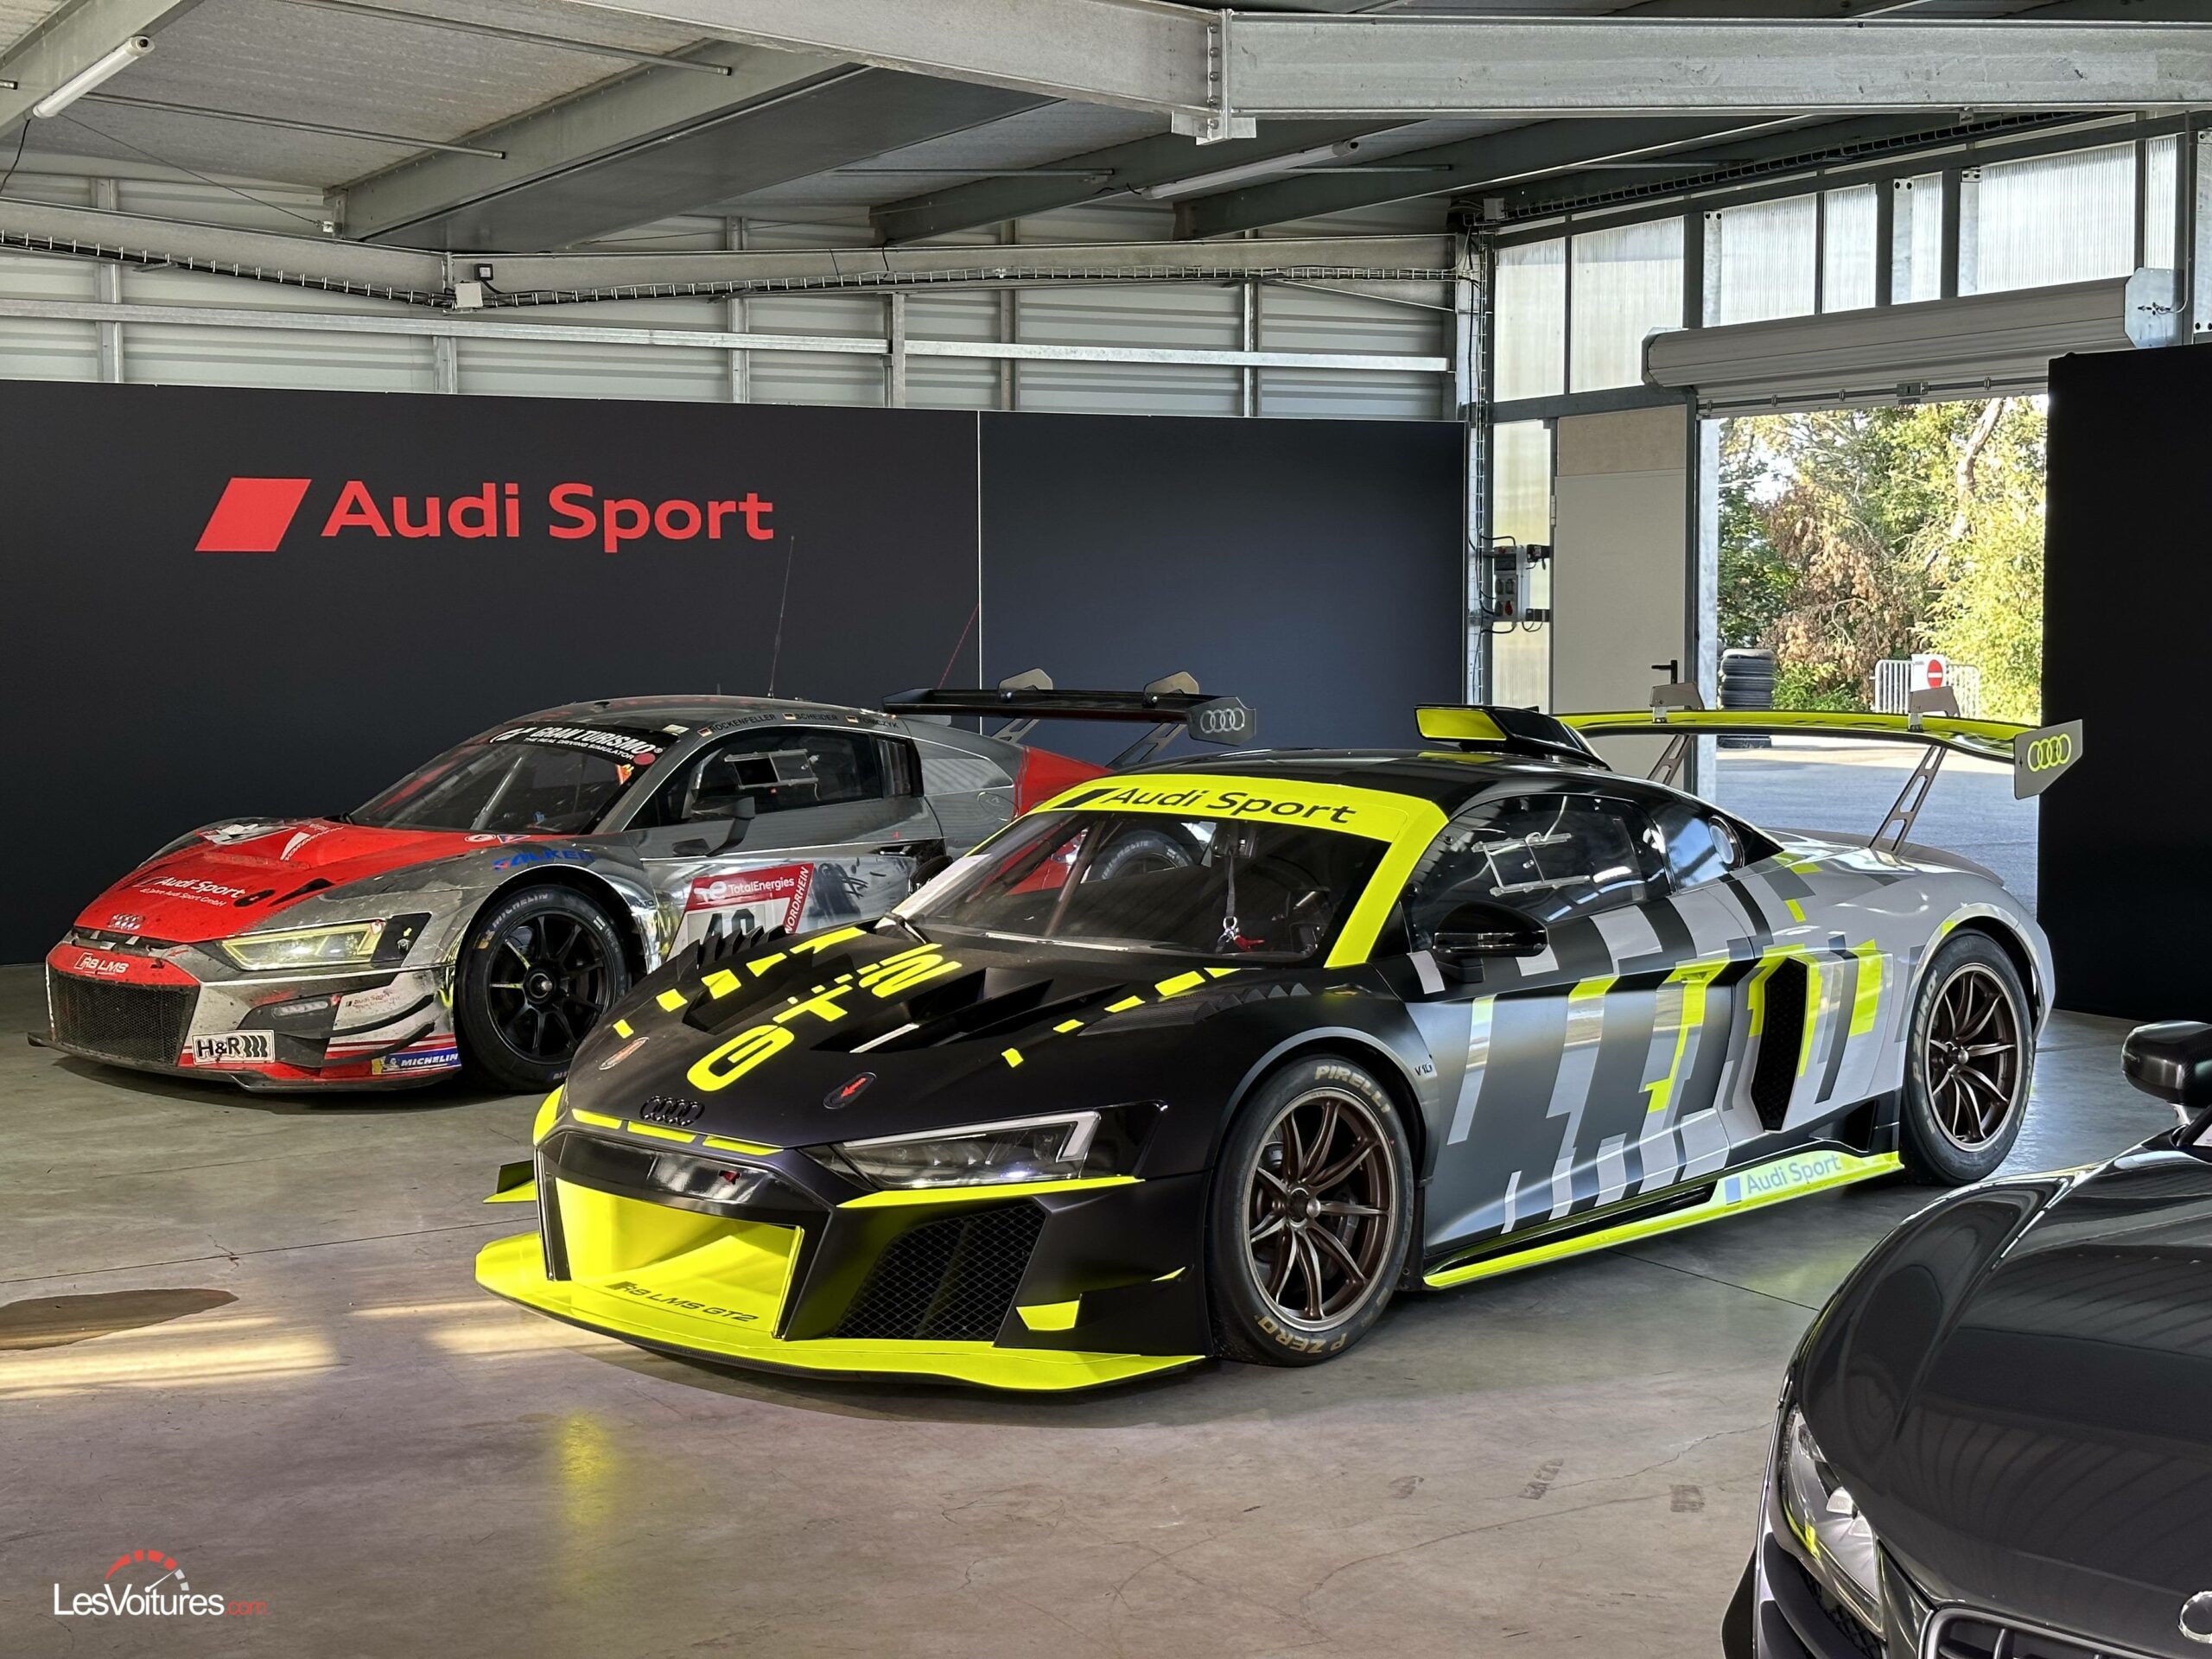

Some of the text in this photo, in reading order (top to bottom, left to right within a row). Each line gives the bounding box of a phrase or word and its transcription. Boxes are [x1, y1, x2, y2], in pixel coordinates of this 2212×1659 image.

[321, 480, 774, 553] Audi Sport
[530, 727, 584, 741] GRAN
[710, 714, 777, 733] ROCKENFELLER
[588, 743, 635, 760] SIMULATOR
[1098, 787, 1357, 823] Audi Sport
[155, 876, 245, 899] Audi Sport
[728, 876, 795, 895] TotalEnergies
[784, 866, 810, 934] NORDRHEIN
[80, 955, 130, 974] R8 LMS
[197, 1037, 241, 1057] H&R
[400, 1053, 459, 1067] MICHELIN
[1414, 1063, 1433, 1077] V10
[1314, 1065, 1391, 1114] PIRELLI
[1746, 1154, 1842, 1194] Audi Sport
[621, 1282, 760, 1323] R8 LMS GT2
[1257, 1314, 1327, 1354] ZERO
